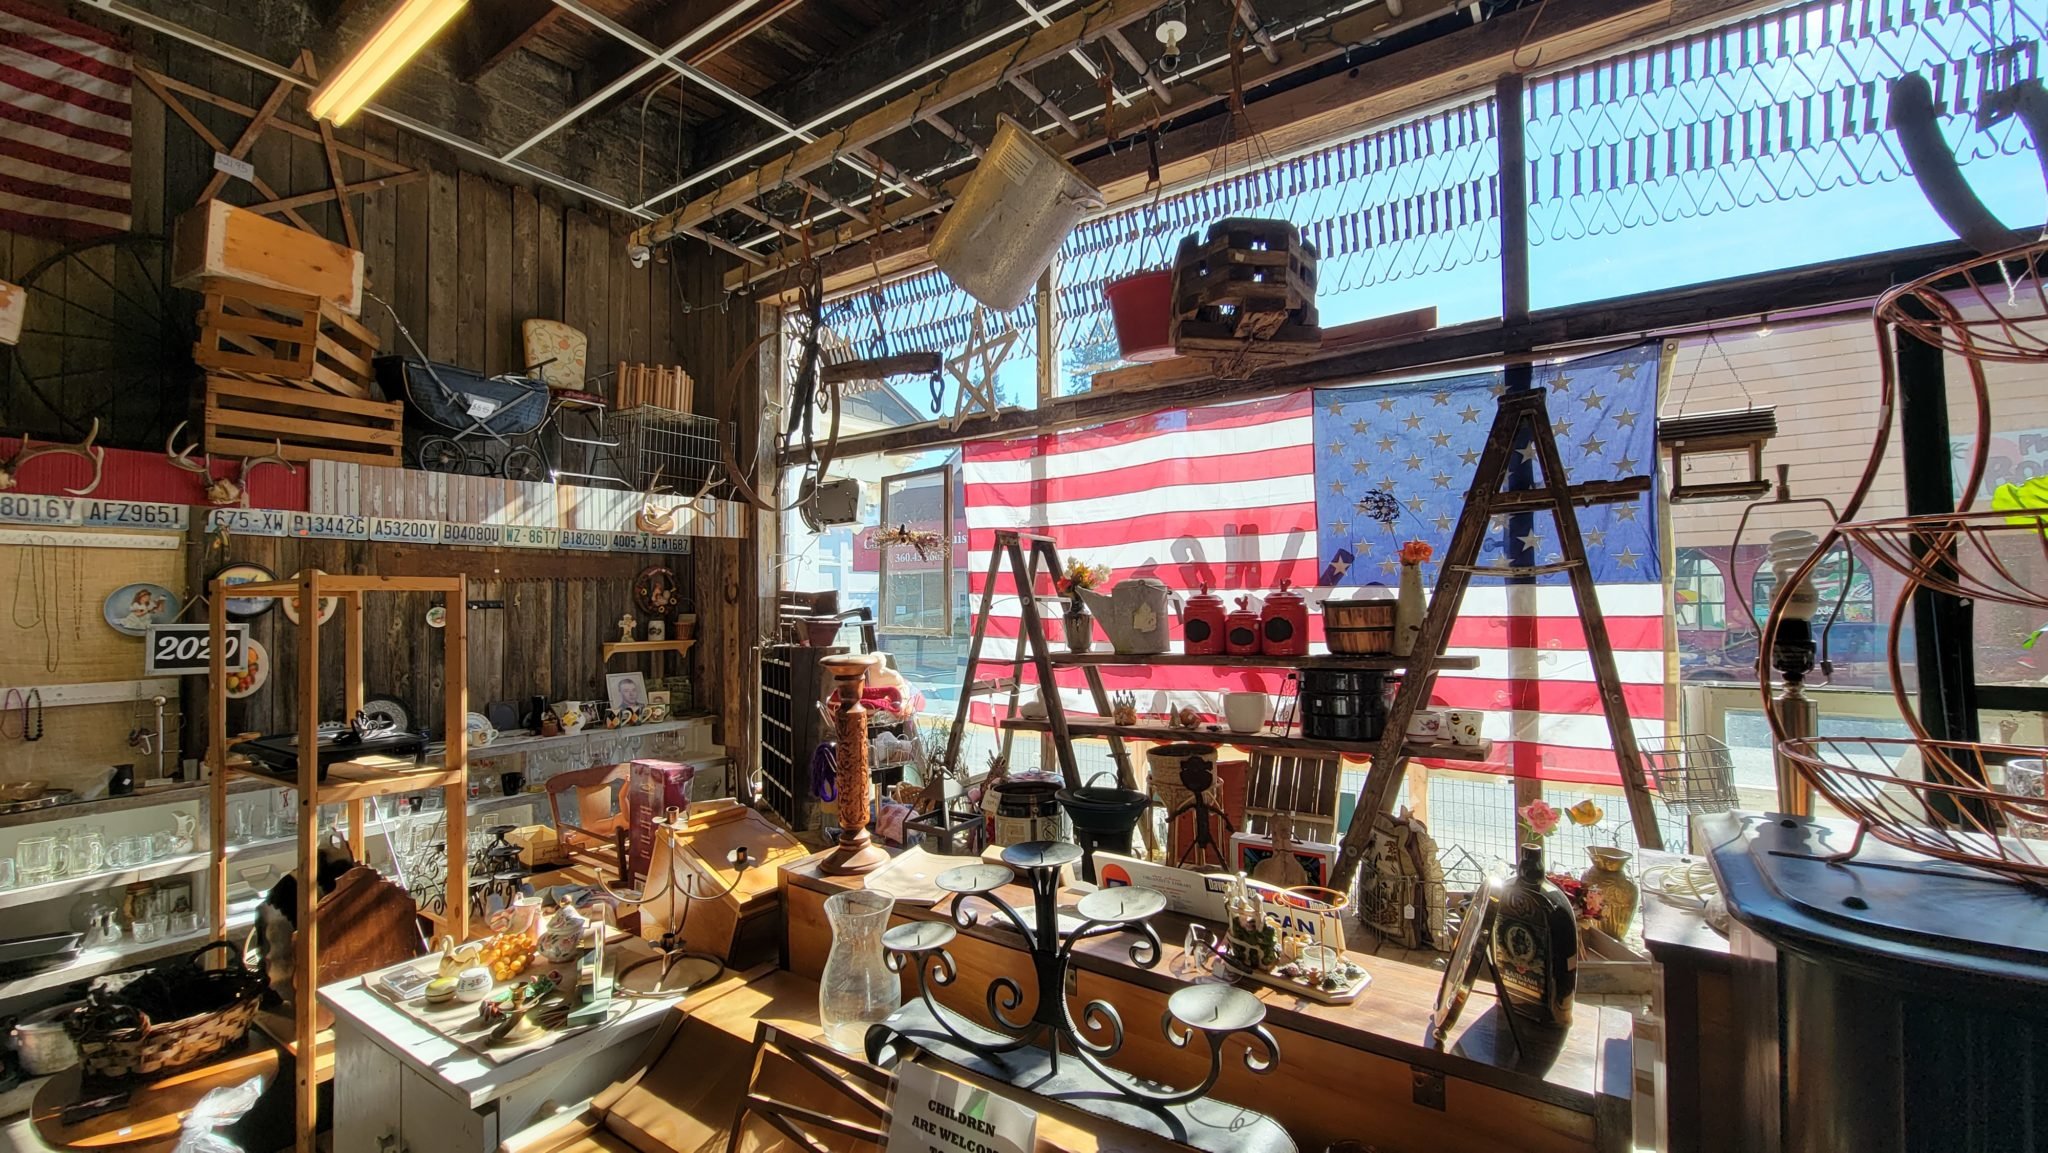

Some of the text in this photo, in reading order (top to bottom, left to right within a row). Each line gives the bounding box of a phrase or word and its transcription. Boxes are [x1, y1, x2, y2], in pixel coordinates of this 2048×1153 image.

[1, 496, 75, 519] 8016Y
[89, 502, 179, 524] AFZ9651
[214, 510, 284, 530] 675-XW
[294, 515, 365, 534] B13442G
[375, 520, 437, 538] A53200Y
[443, 524, 500, 542] B04080U
[506, 528, 556, 545] WZ-8617
[562, 532, 608, 547] B18209U
[651, 537, 689, 551] BTM1687
[155, 636, 239, 660] 2020
[927, 1099, 997, 1138] CHILDREN
[912, 1115, 1000, 1153] ARE WELCOM
